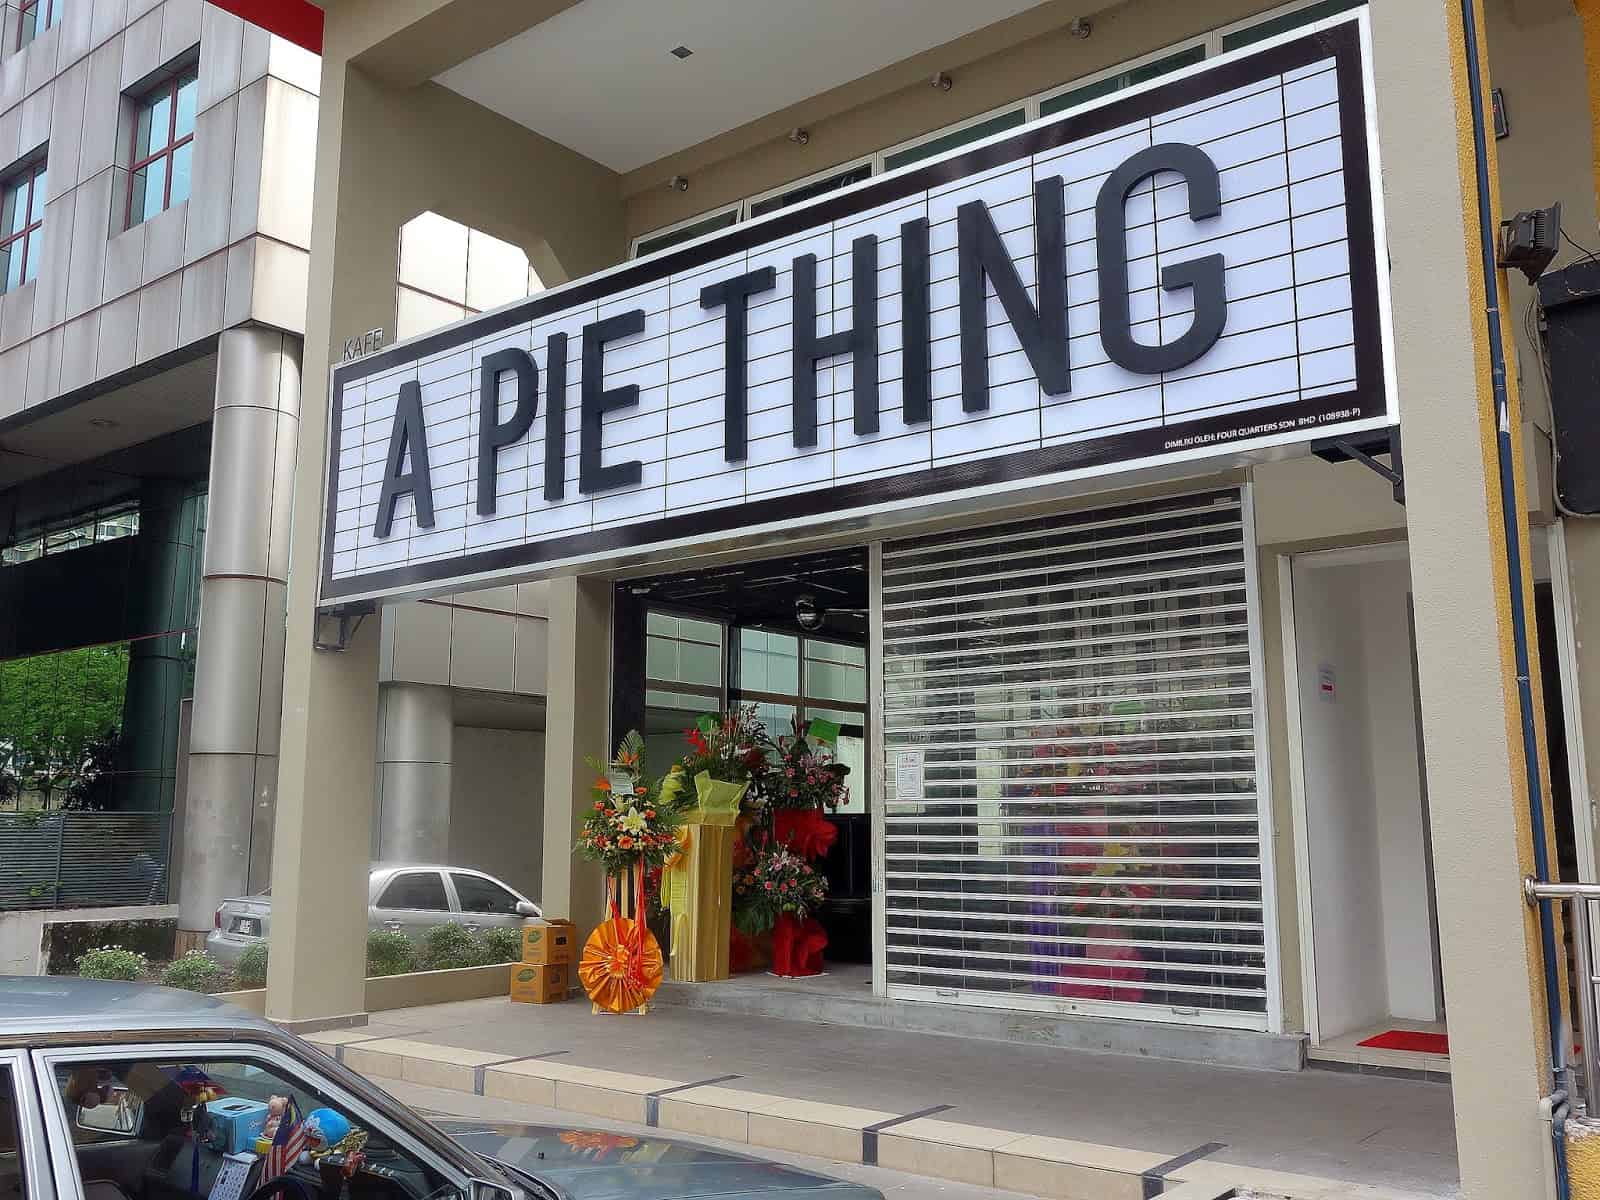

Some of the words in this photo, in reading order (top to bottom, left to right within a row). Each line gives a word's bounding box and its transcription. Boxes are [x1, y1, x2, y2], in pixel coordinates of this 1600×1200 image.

[343, 328, 384, 362] KAFE
[373, 379, 436, 539] A
[476, 308, 646, 517] PIE
[699, 142, 1229, 463] THING
[1216, 429, 1237, 441] FOUR
[1238, 421, 1278, 437] QUARTERS
[1278, 419, 1296, 429] SDN
[1298, 415, 1316, 426] BHD
